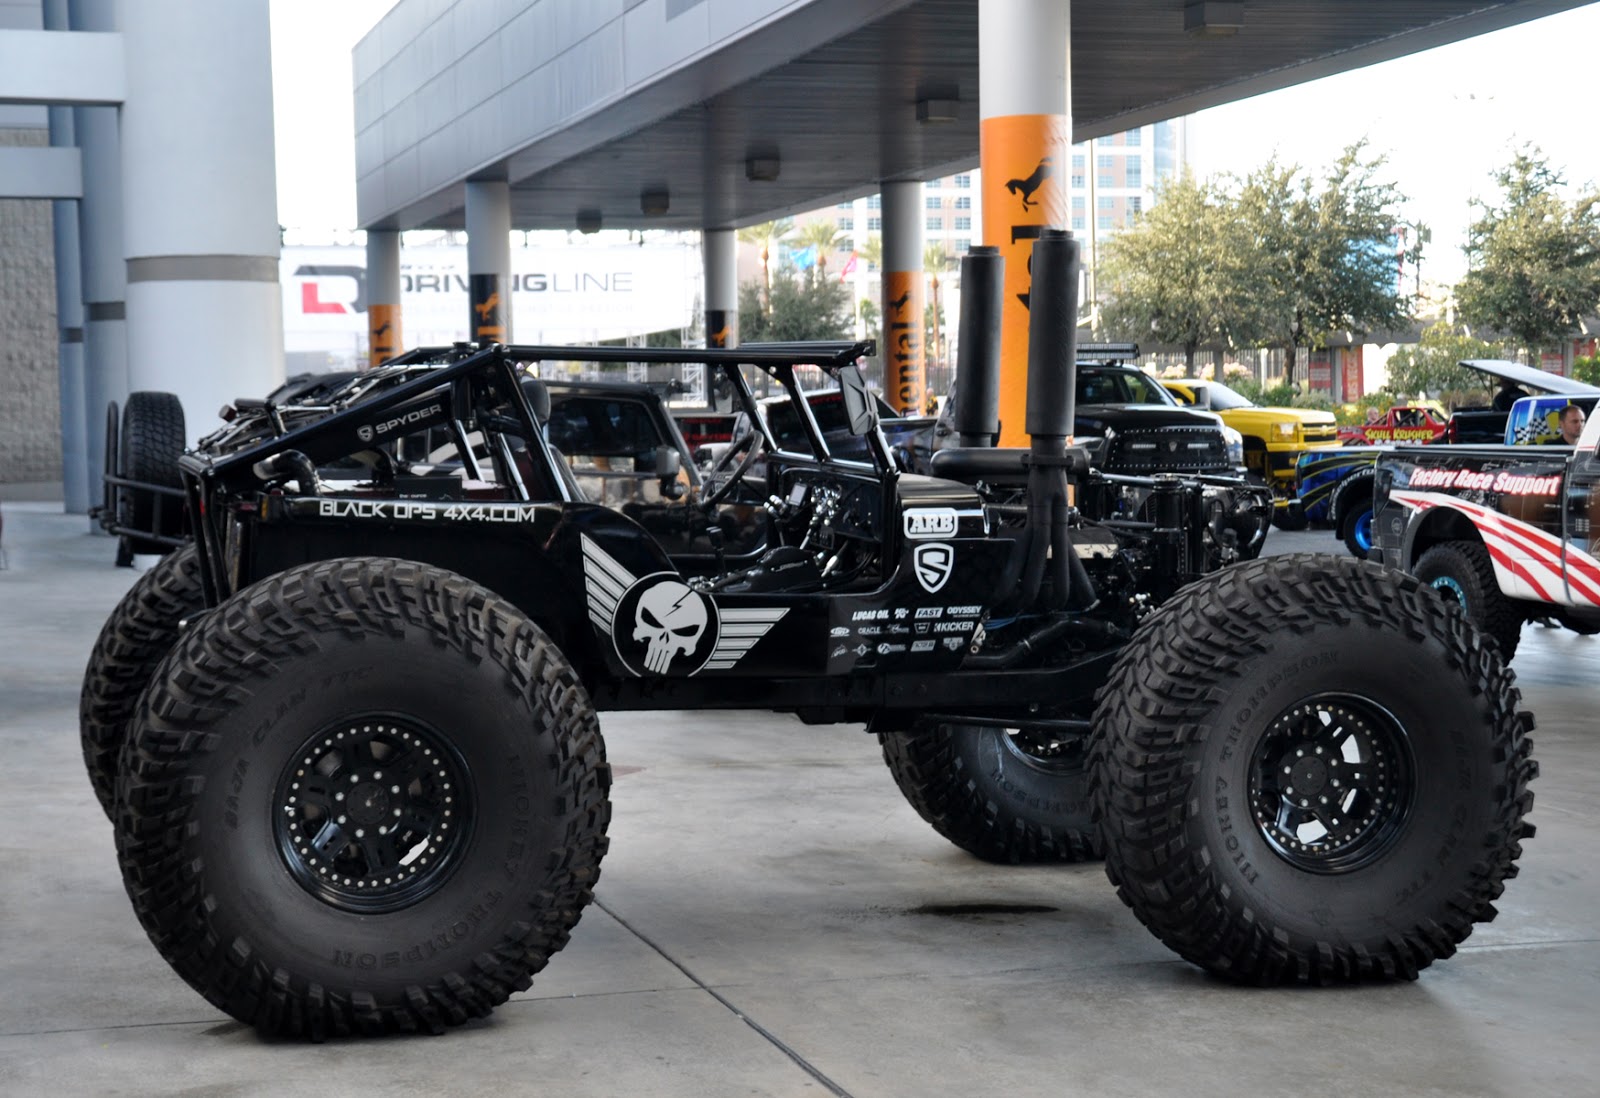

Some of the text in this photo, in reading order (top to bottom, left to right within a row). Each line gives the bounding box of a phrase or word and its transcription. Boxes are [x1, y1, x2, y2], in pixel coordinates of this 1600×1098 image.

[375, 403, 442, 434] SPYDER
[1365, 428, 1390, 440] SKULL
[1393, 428, 1434, 440] KRUSHER
[1409, 468, 1561, 495] Factory Race Support
[319, 500, 535, 523] BLACK OPS 4X4.COM
[910, 513, 954, 534] ARB
[852, 610, 877, 621] LUCAS
[877, 609, 889, 619] OIL
[917, 608, 940, 616] FAST
[947, 605, 982, 615] ODYSSEY
[858, 626, 881, 635] ORACLE
[940, 621, 974, 632] KICKER
